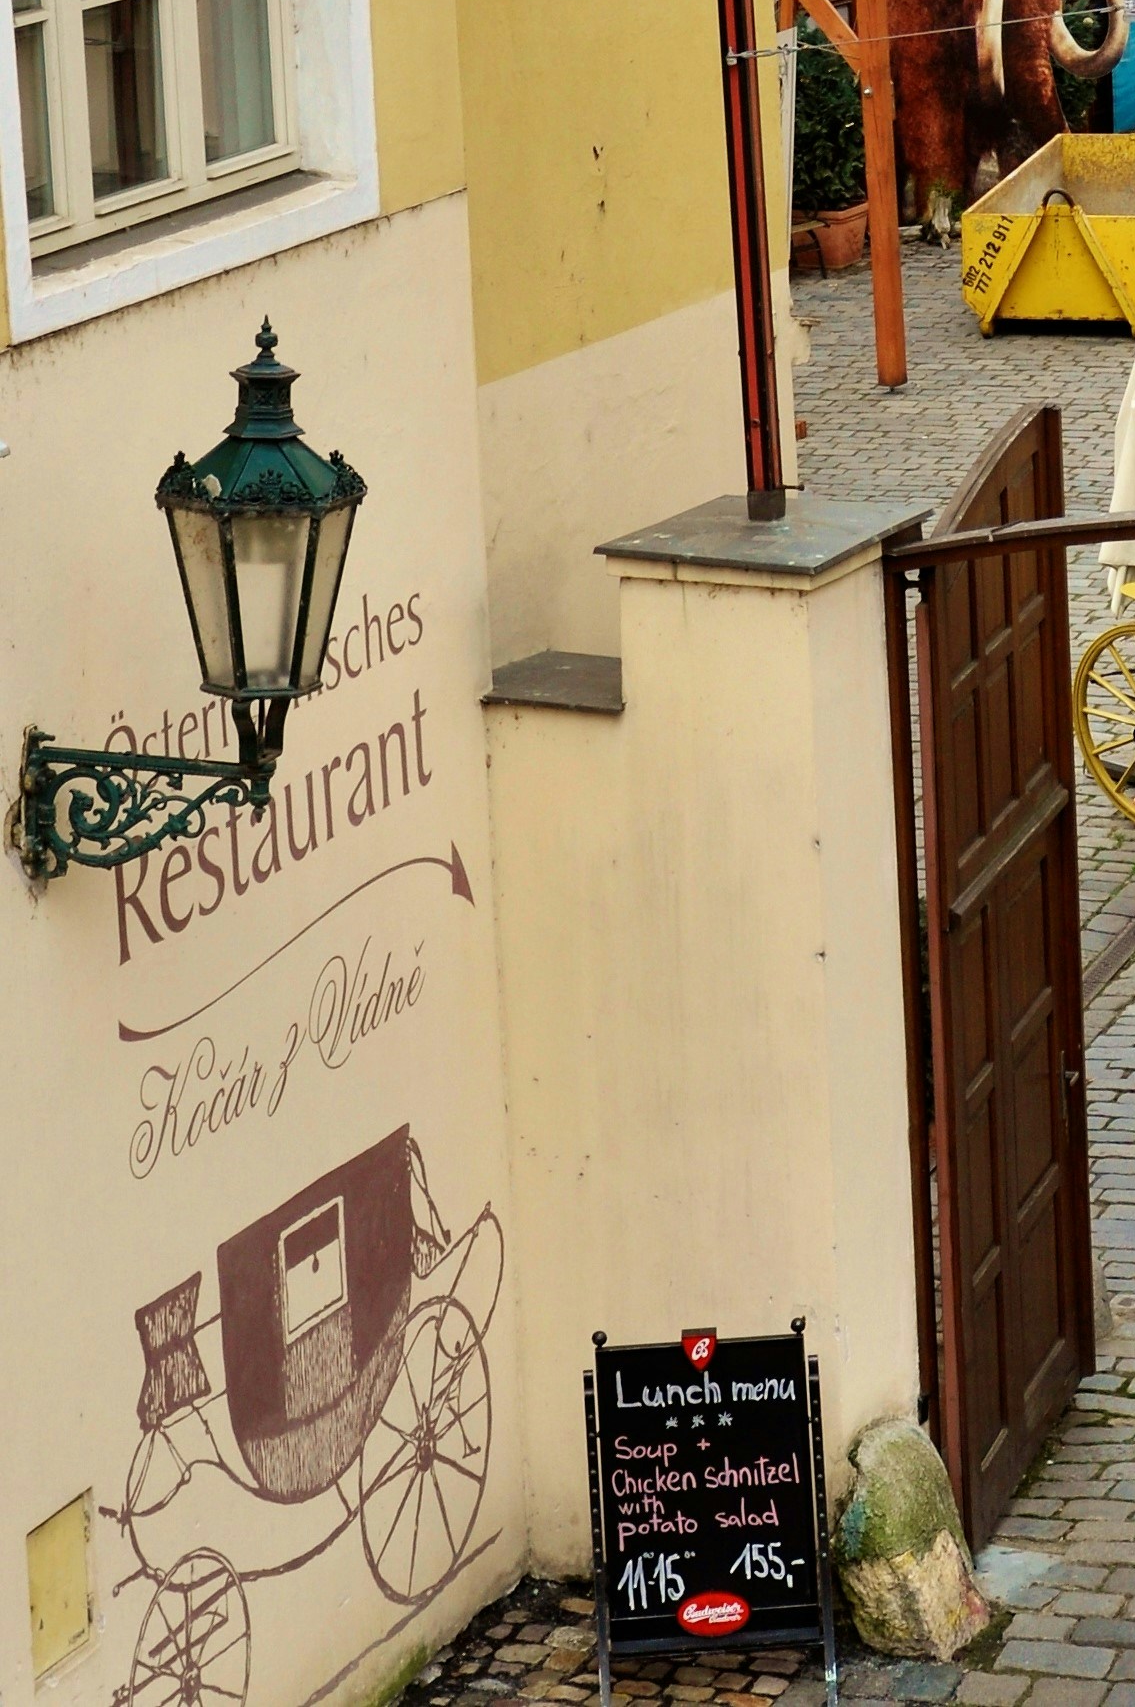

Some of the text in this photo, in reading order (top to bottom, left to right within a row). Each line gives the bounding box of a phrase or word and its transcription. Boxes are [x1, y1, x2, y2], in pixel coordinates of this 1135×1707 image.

[975, 215, 1014, 294] 777 212 911
[114, 688, 433, 966] Restaurant
[130, 1036, 268, 1180] Kočár
[308, 935, 427, 1070] Vídně
[615, 1370, 796, 1409] Lunch menu
[614, 1435, 678, 1468] Soup
[611, 1465, 697, 1497] Chicken
[617, 1496, 780, 1552] potato salad
[618, 1494, 665, 1516] with
